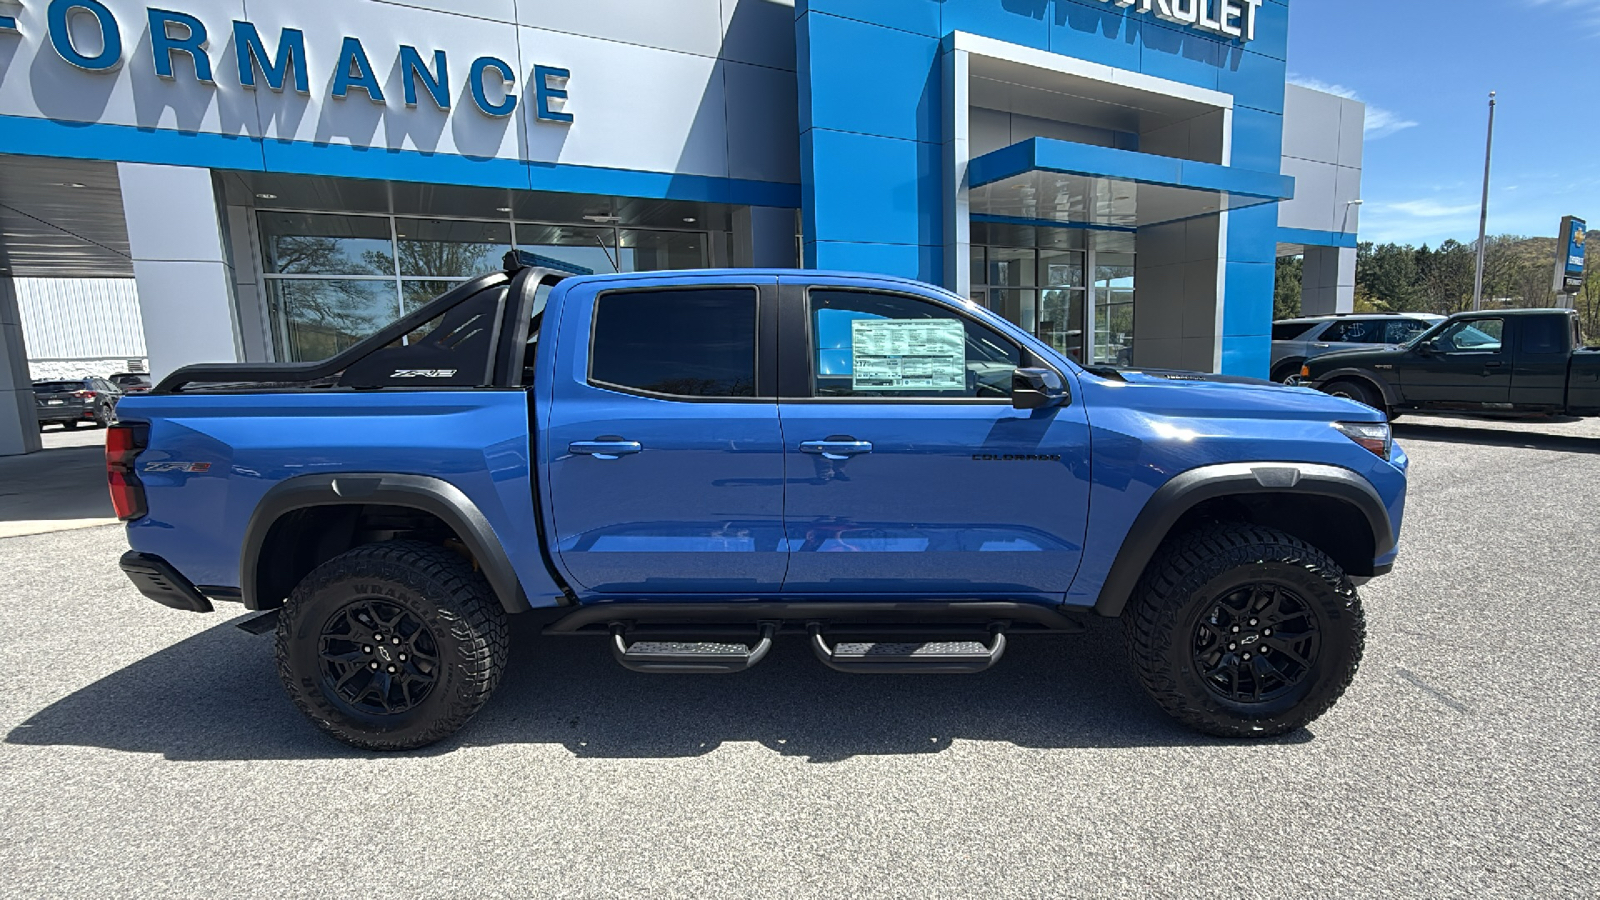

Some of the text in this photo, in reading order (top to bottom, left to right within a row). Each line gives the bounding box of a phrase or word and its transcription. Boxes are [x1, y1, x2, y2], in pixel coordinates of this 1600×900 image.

[0, 0, 575, 125] ORMANCE
[389, 369, 457, 378] ZR2
[143, 461, 212, 473] ZR2
